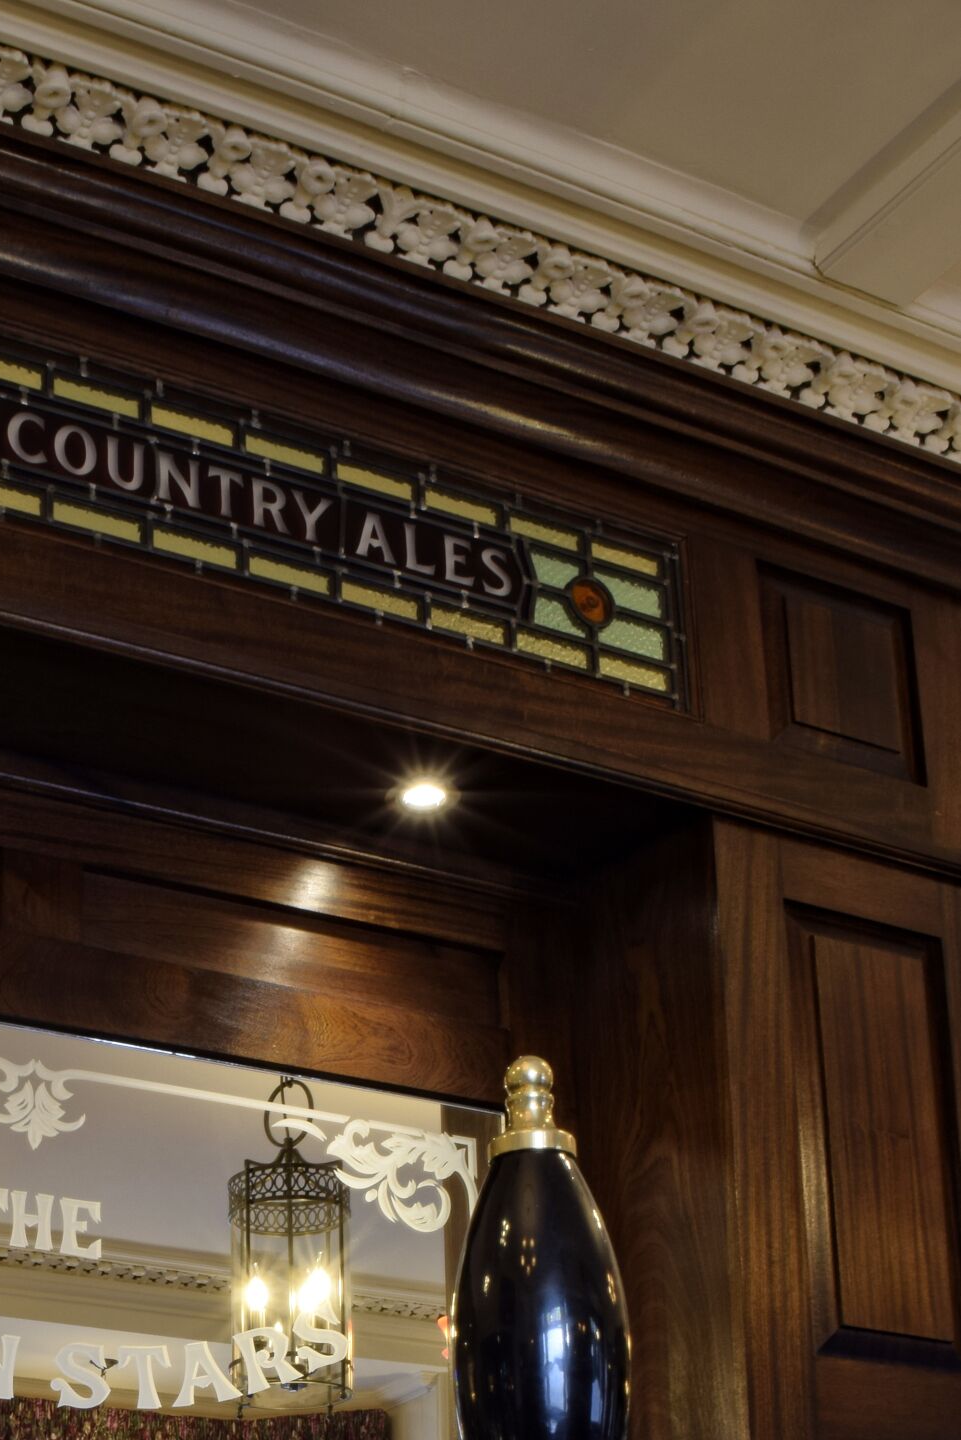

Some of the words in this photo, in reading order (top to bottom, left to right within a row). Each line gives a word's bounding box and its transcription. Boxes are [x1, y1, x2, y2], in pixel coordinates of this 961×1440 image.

[6, 410, 332, 542] COUNTRY
[355, 512, 512, 599] ALES
[50, 1296, 349, 1409] STARS
